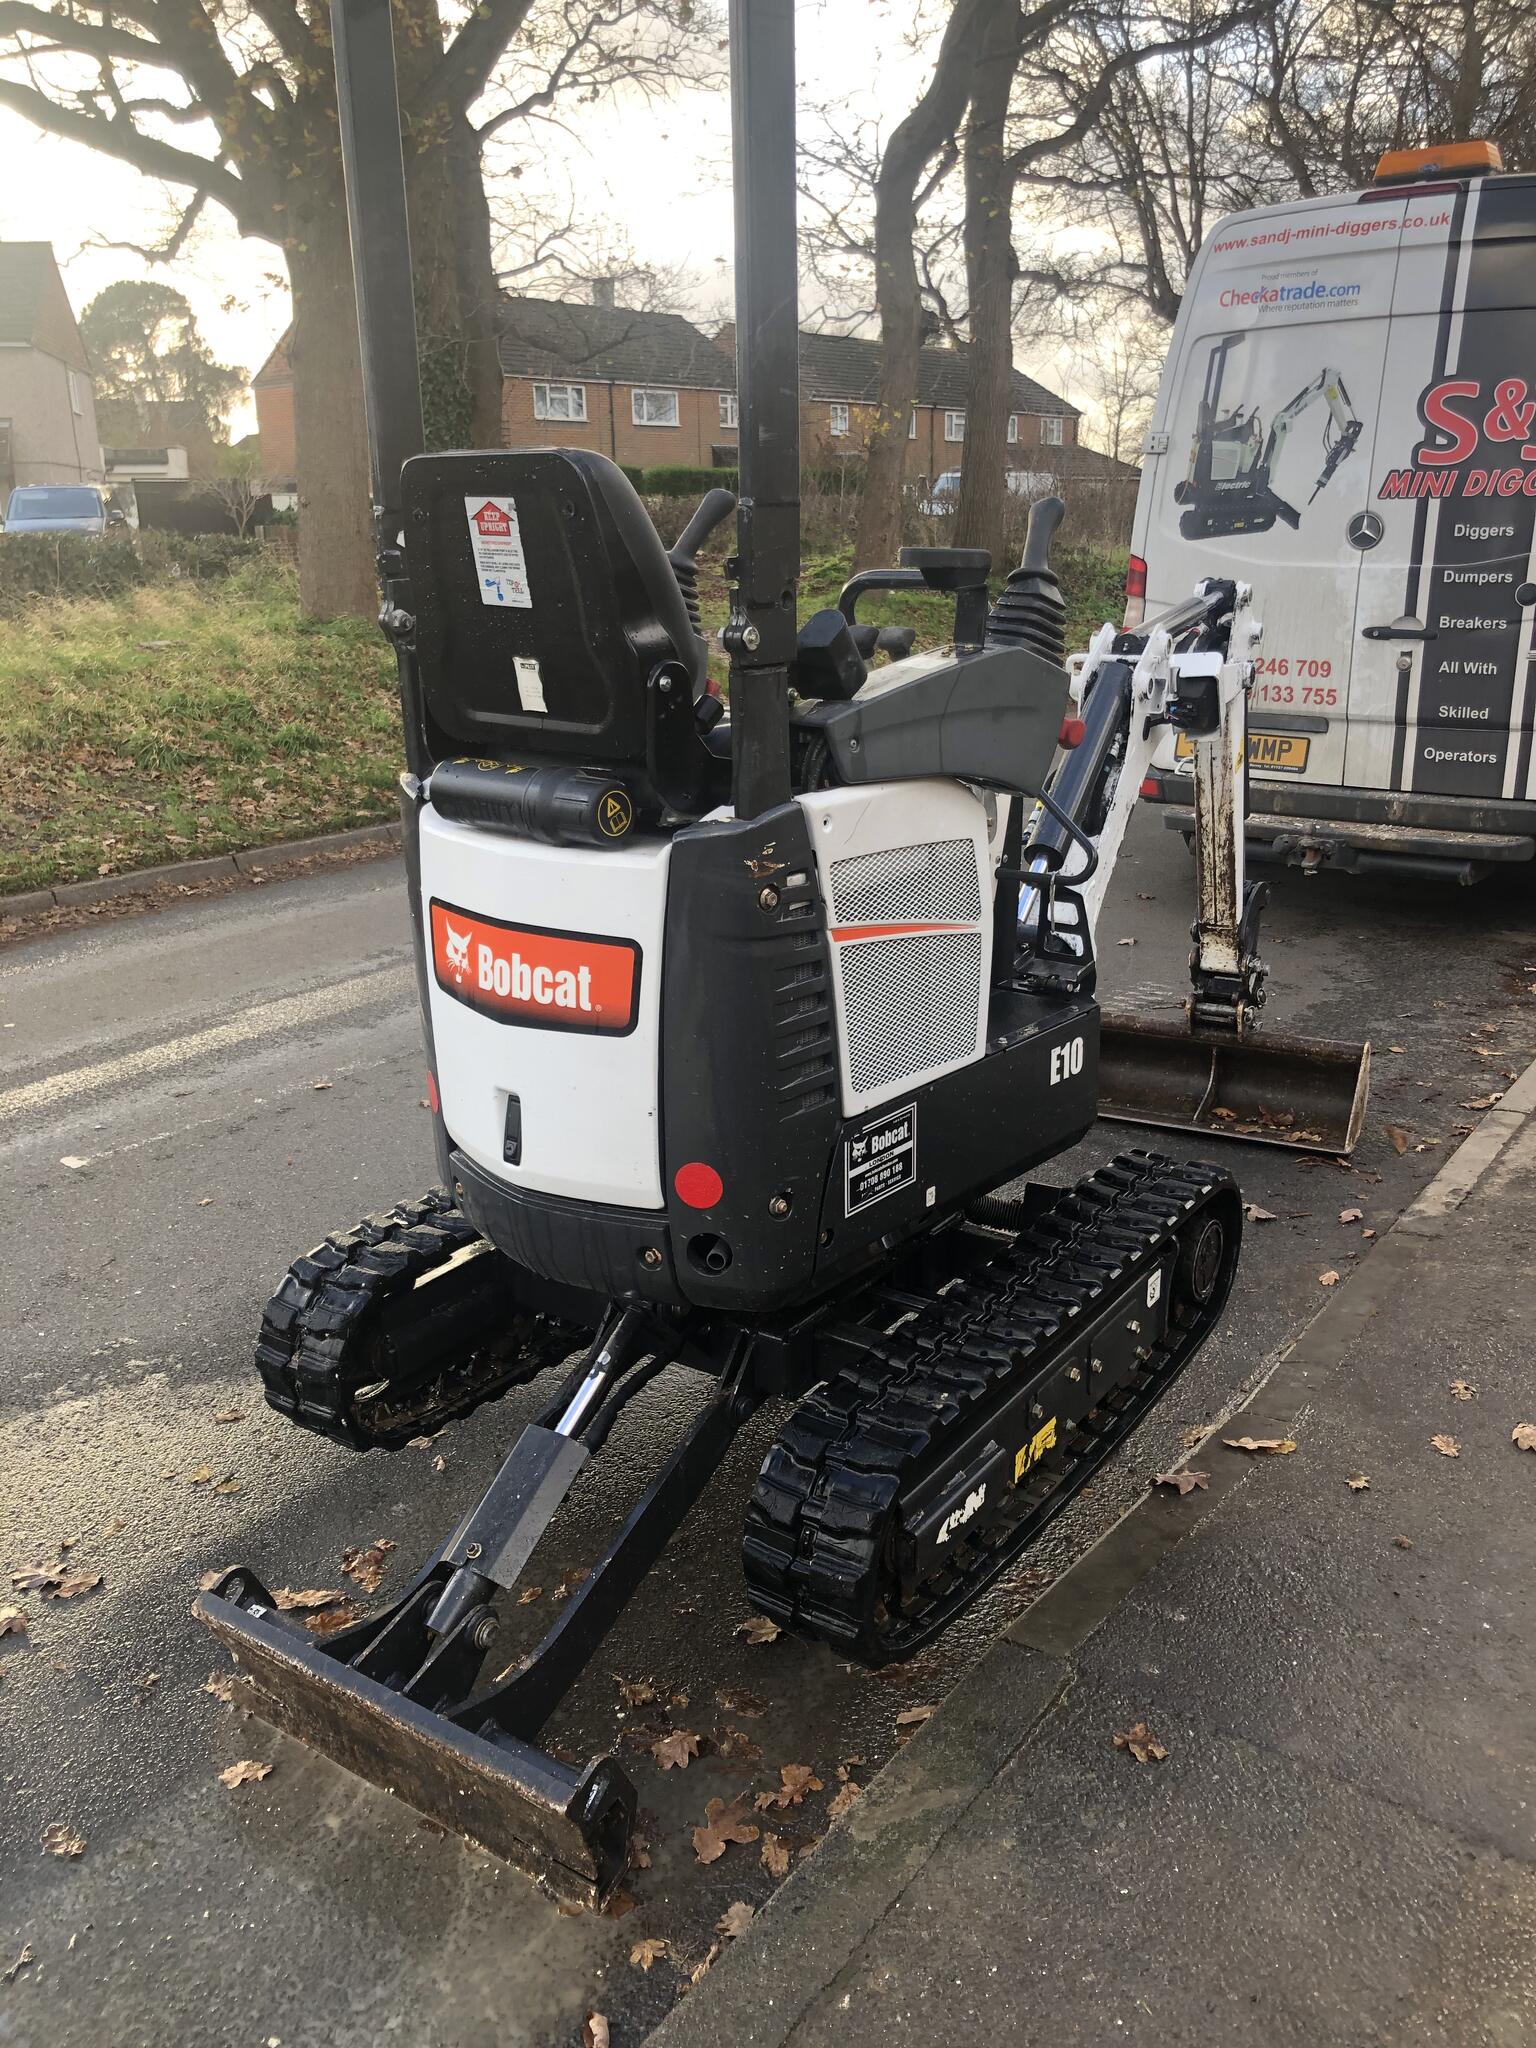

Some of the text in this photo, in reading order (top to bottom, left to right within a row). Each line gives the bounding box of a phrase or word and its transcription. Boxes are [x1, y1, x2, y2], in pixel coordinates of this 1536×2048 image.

[1213, 212, 1450, 254] www.sandj-mini-diggers.co.uk
[1219, 281, 1361, 307] Checkatrade.com
[1258, 298, 1359, 313] Where reputation matters
[1417, 378, 1536, 466] S&
[1379, 469, 1459, 498] MINI
[480, 521, 509, 533] UPRIGHT
[1453, 524, 1515, 540] Diggers
[1443, 570, 1513, 586] Dumpers
[1439, 616, 1508, 630] Breakers
[1254, 657, 1332, 679] 246 709
[1438, 661, 1498, 675] All With
[1302, 687, 1337, 706] 755
[1438, 705, 1489, 720] Skilled
[1248, 737, 1293, 761] WMP
[1423, 747, 1497, 764] Operators
[478, 943, 592, 1012] Bobcat
[1050, 1036, 1084, 1086] E10
[871, 1121, 909, 1155] Bobcat
[868, 1150, 894, 1168] LONDON
